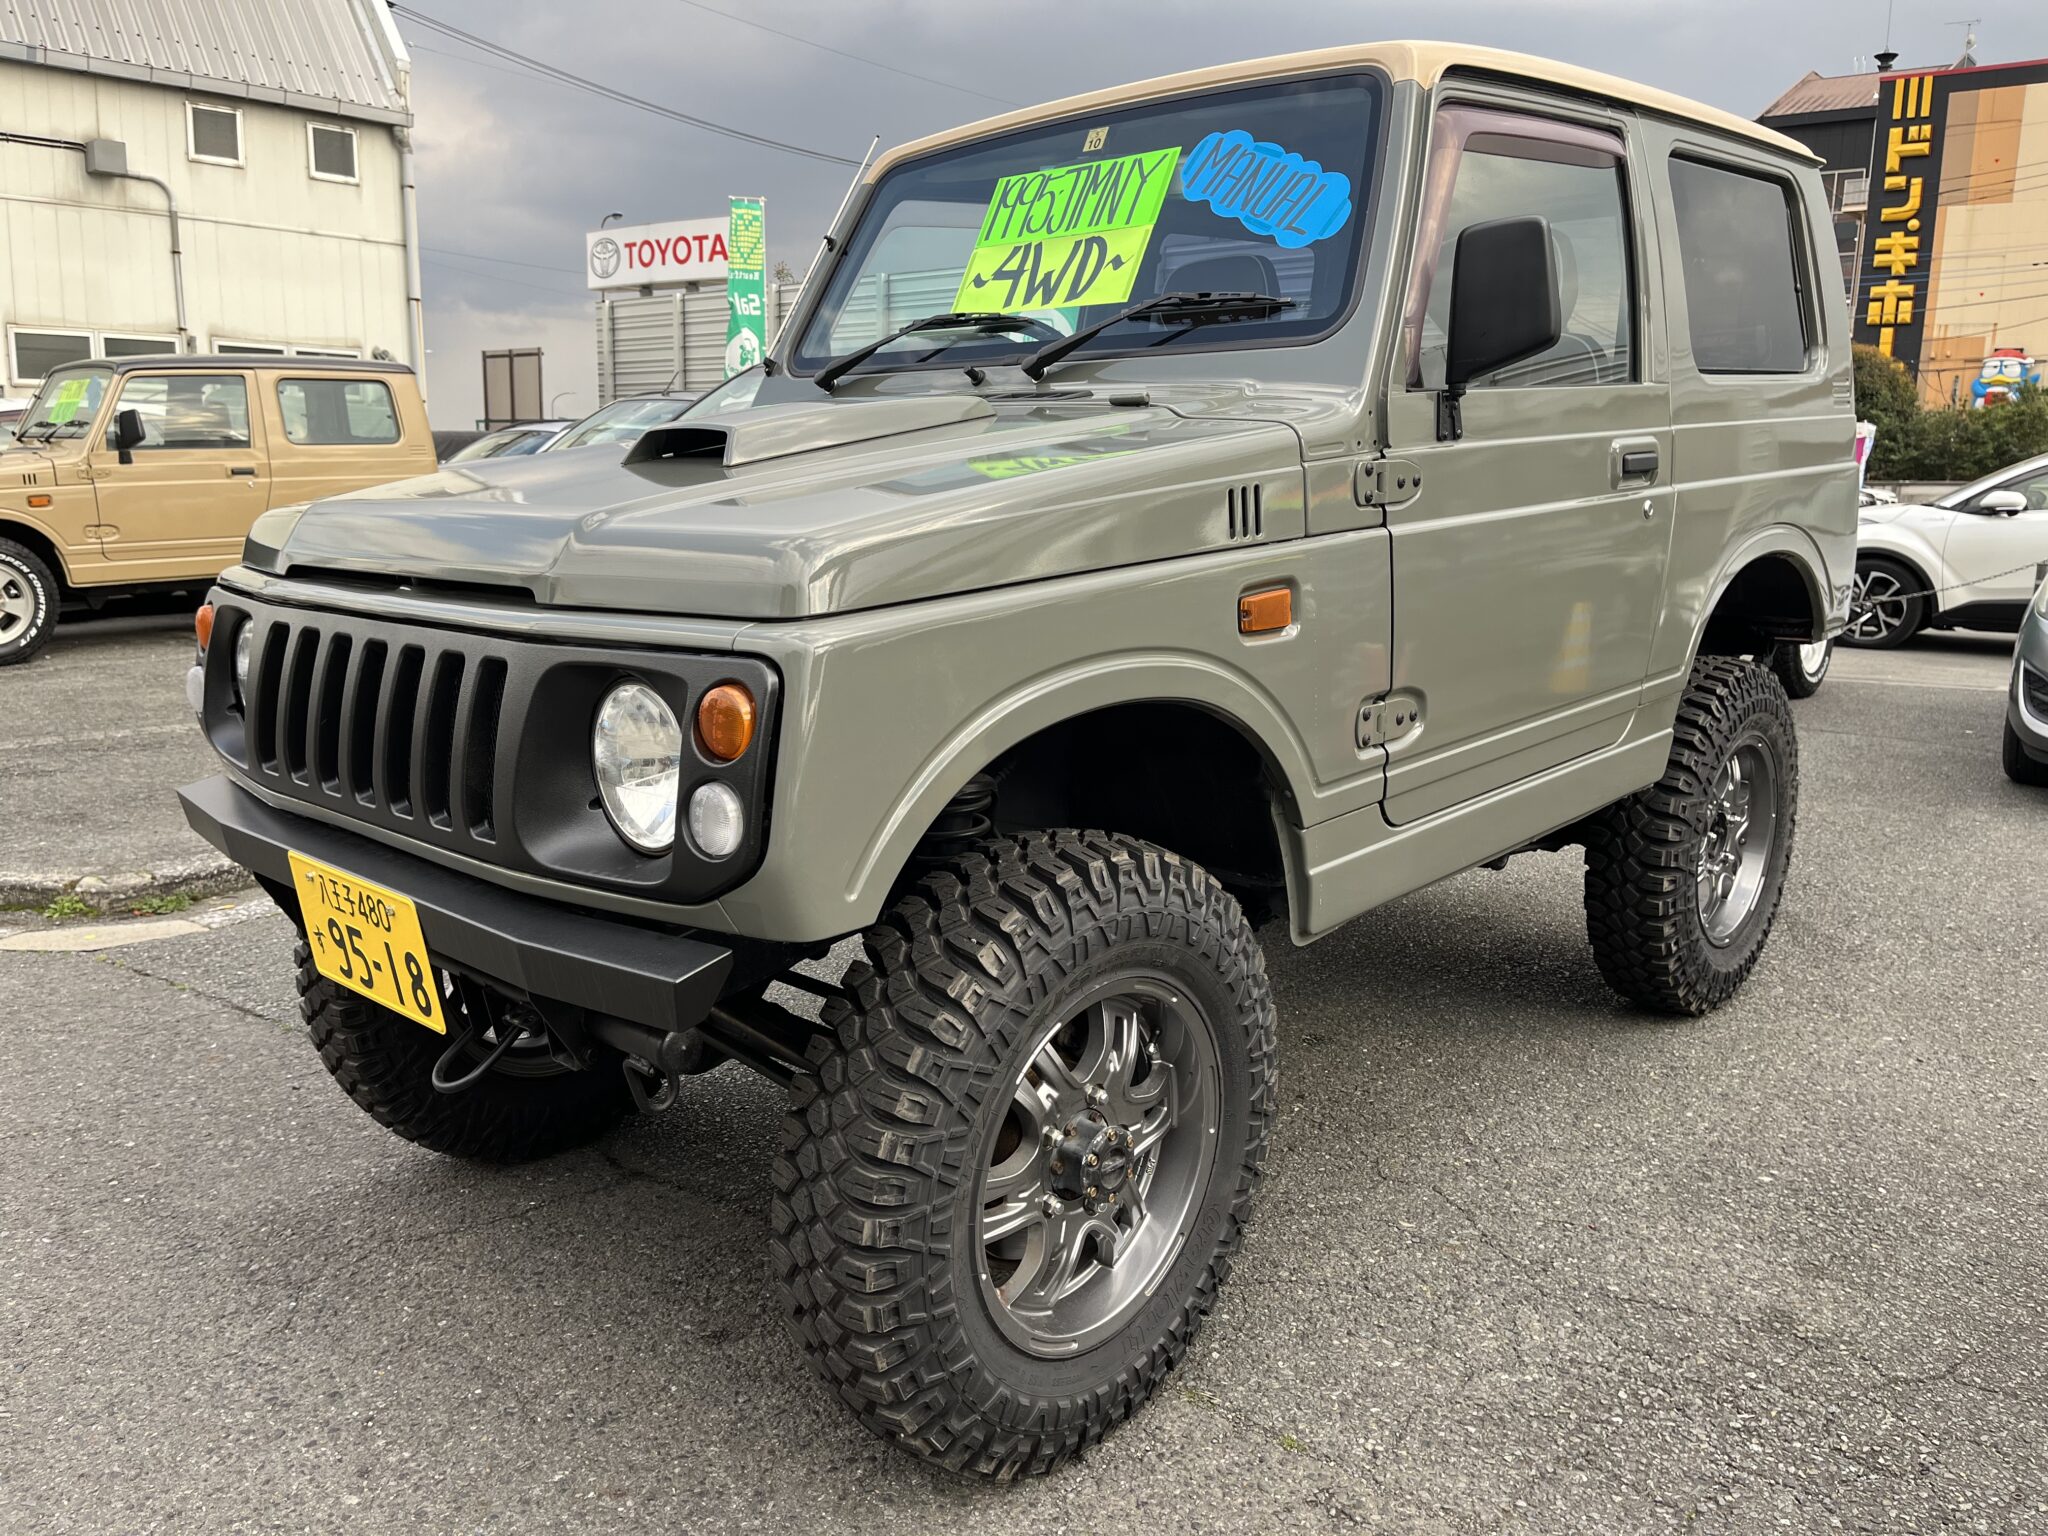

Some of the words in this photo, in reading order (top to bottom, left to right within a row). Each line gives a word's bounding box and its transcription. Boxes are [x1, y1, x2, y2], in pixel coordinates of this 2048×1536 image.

[1088, 138, 1102, 150] 10
[1186, 137, 1328, 235] MANUAL
[624, 233, 729, 270] TOYOTA
[28, 573, 46, 627] COUNTRY
[327, 917, 432, 1018] 95-18
